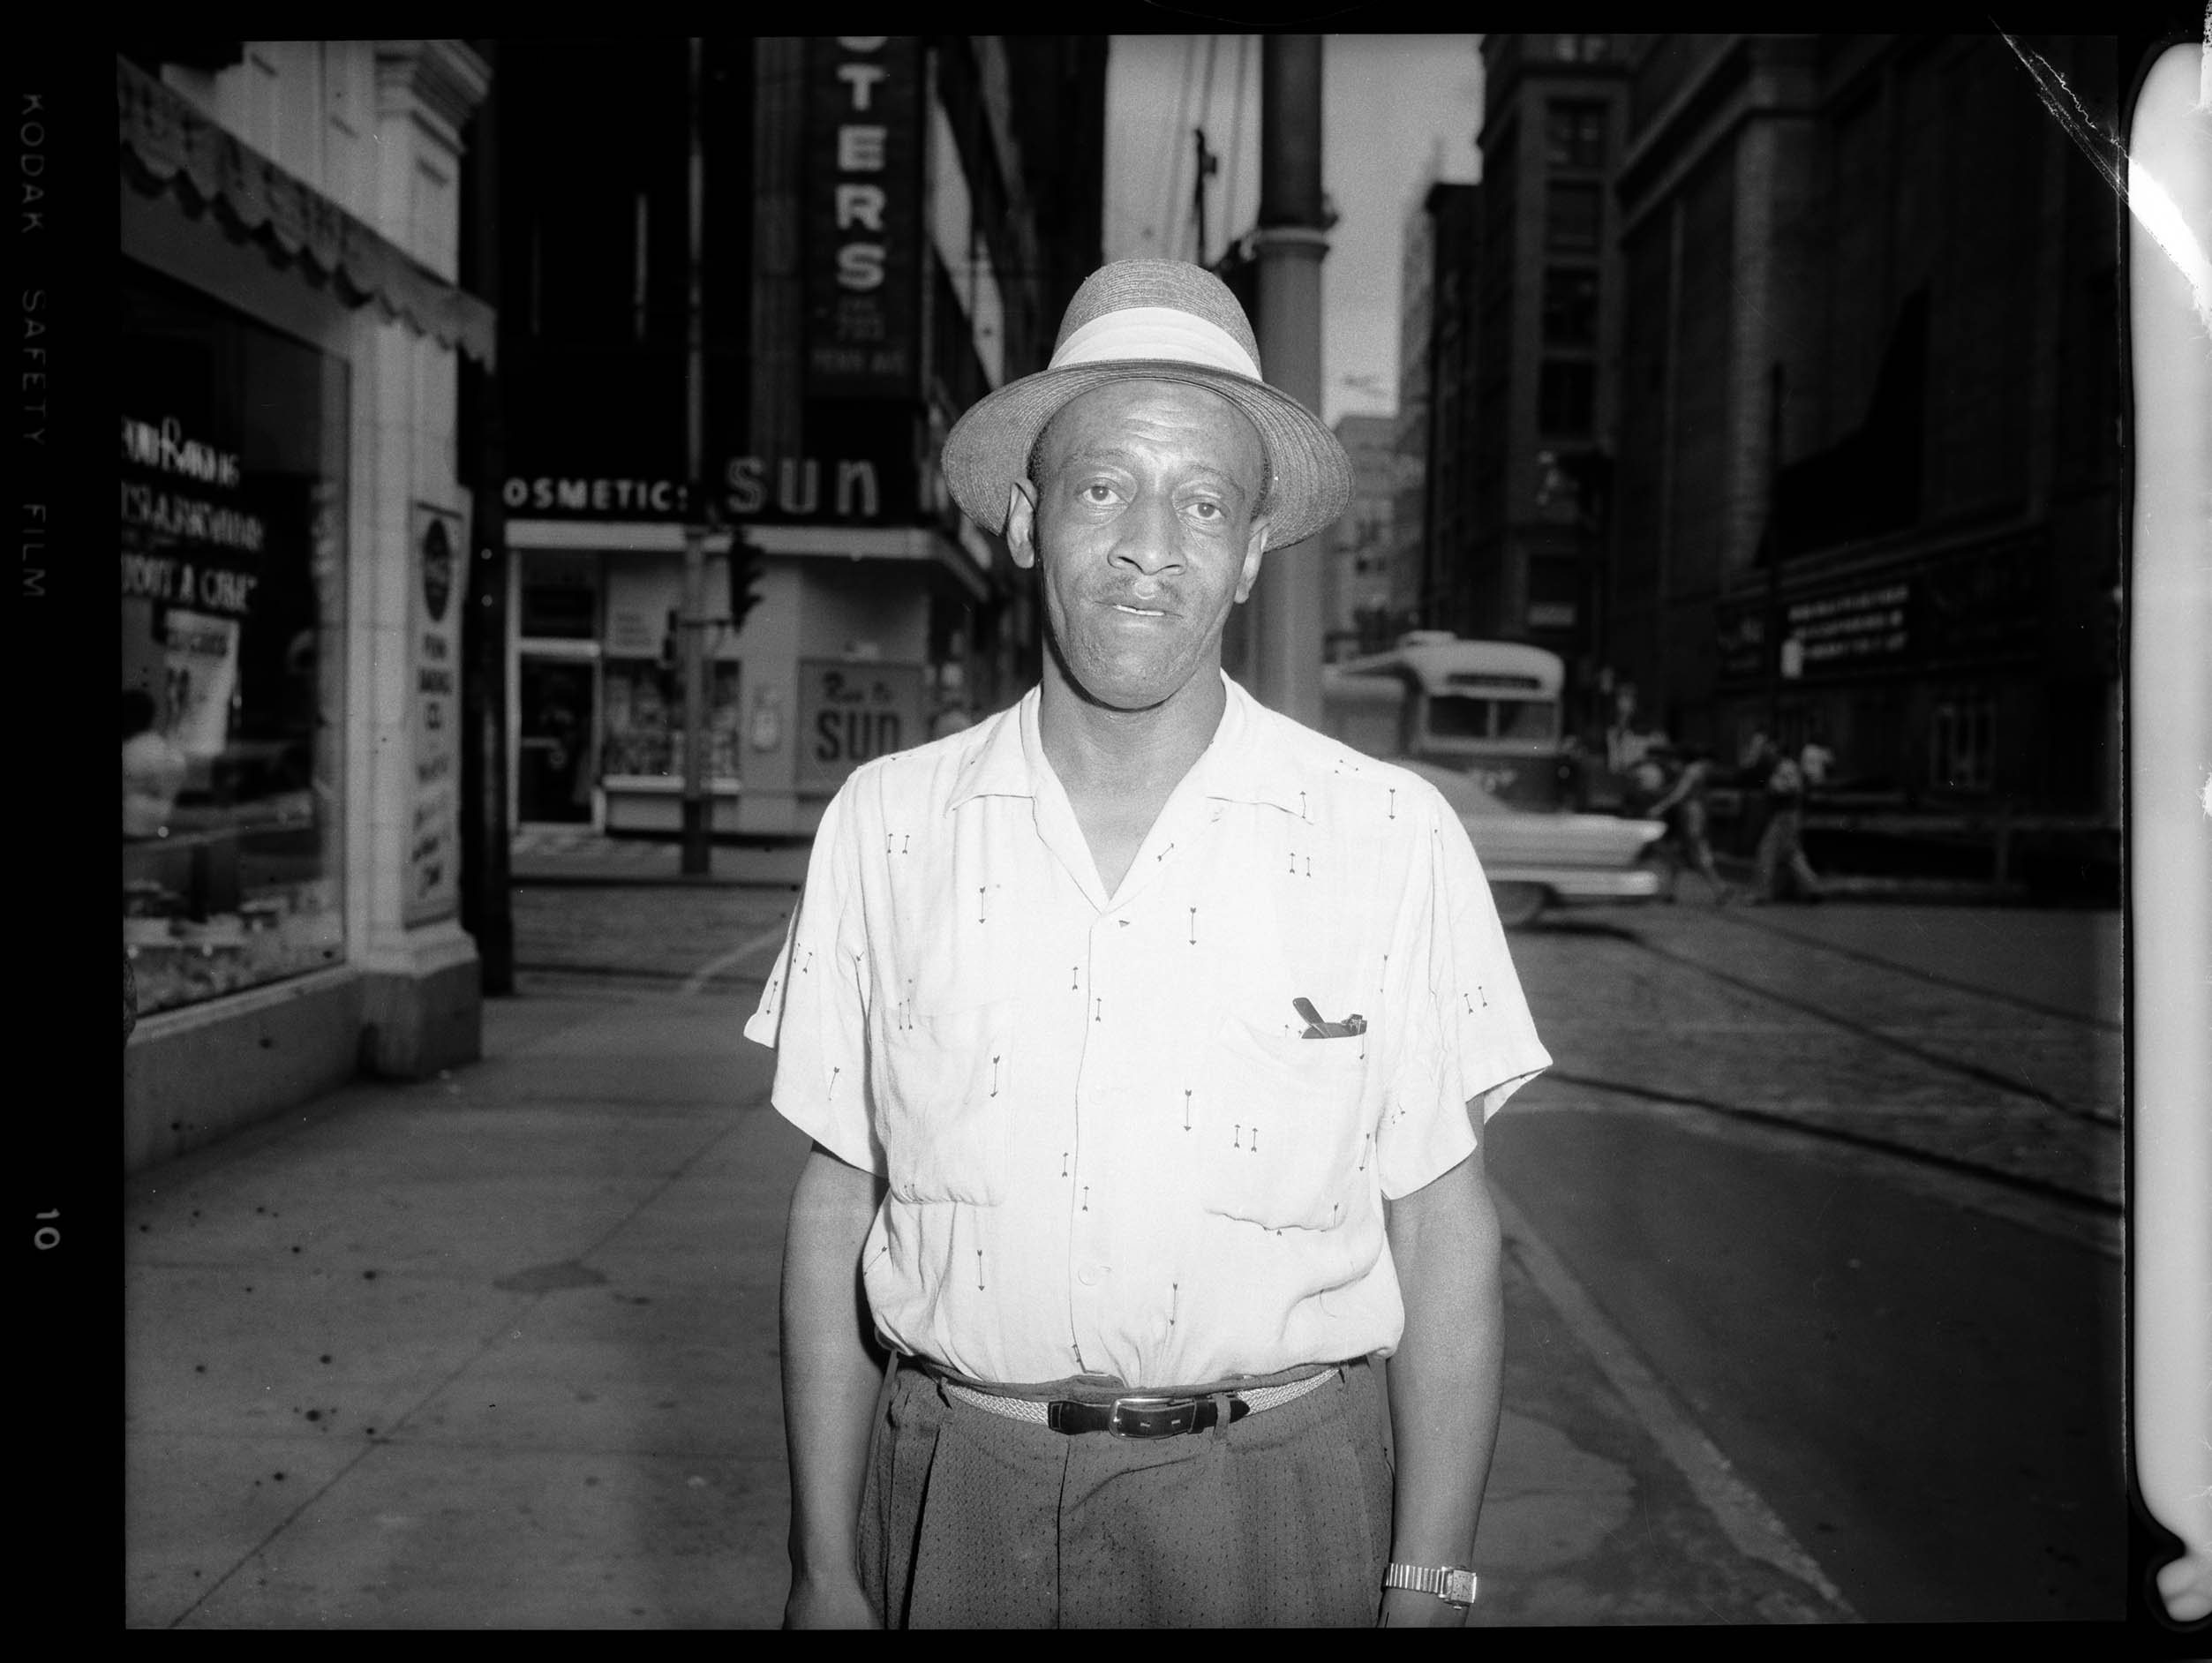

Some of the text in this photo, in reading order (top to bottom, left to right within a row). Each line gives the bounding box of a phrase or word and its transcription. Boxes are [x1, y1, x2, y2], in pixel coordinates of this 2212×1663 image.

[20, 94, 46, 597] KODAK SAFETY FILM
[34, 1209, 60, 1250] 10
